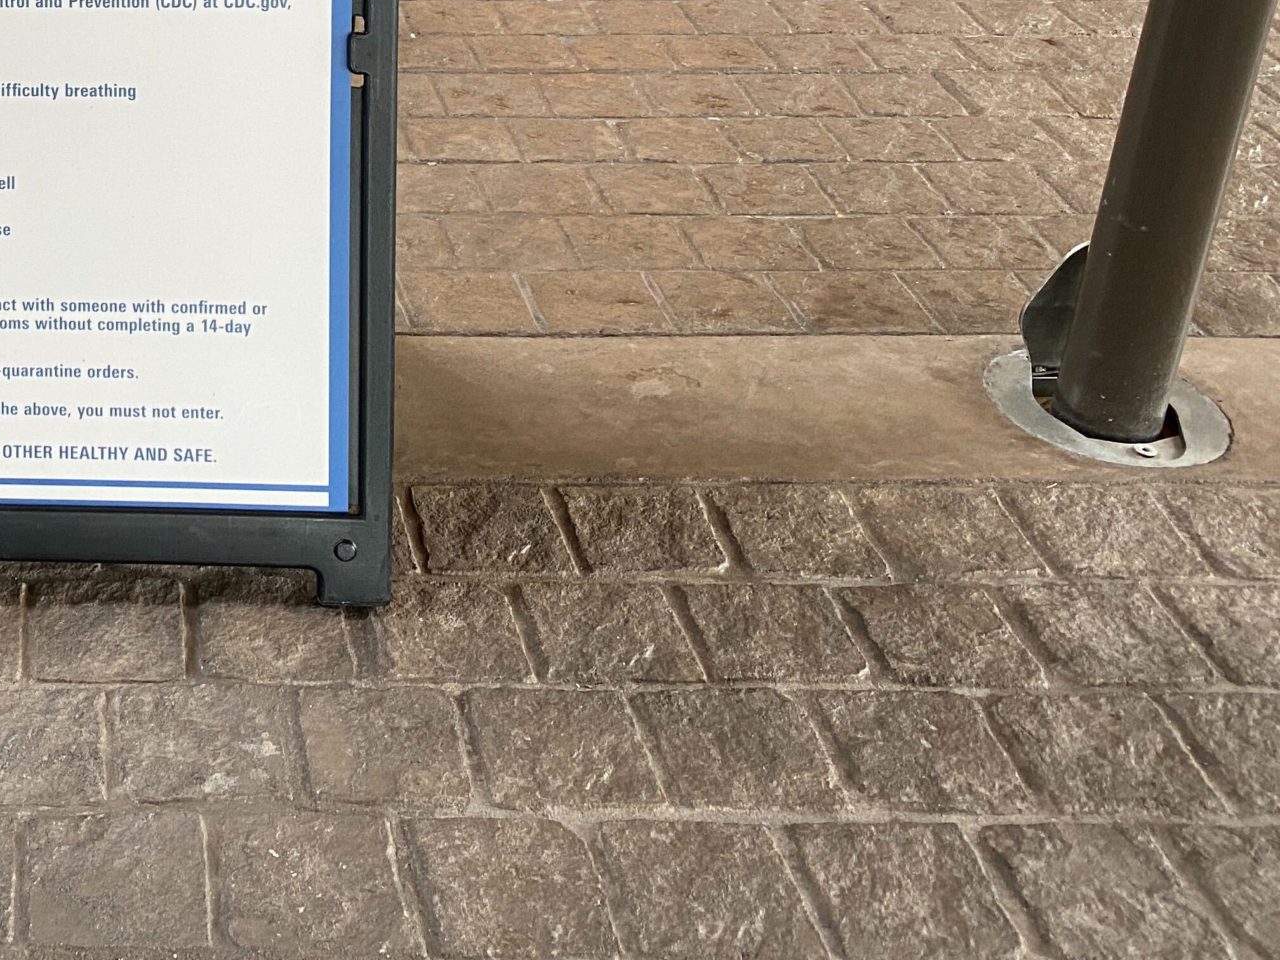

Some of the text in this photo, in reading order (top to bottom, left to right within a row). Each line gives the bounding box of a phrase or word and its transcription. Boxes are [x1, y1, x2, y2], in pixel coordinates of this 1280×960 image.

[65, 83, 136, 101] breathing
[22, 298, 54, 312] with
[60, 302, 126, 313] someone
[132, 299, 165, 313] with
[171, 300, 246, 315] confirmed
[252, 305, 267, 315] or
[35, 316, 92, 331] without
[97, 317, 180, 335] completing
[186, 322, 194, 332] a
[201, 319, 251, 337] 14-day
[87, 364, 138, 379] orders.
[24, 402, 71, 418] above,
[77, 406, 103, 420] you
[110, 406, 146, 418] must
[152, 406, 176, 418] not
[182, 407, 223, 419] enter.
[2, 444, 52, 459] OTHER
[59, 445, 128, 460] HEALTHY
[134, 447, 167, 461] AND
[173, 448, 216, 463] SAFE.
